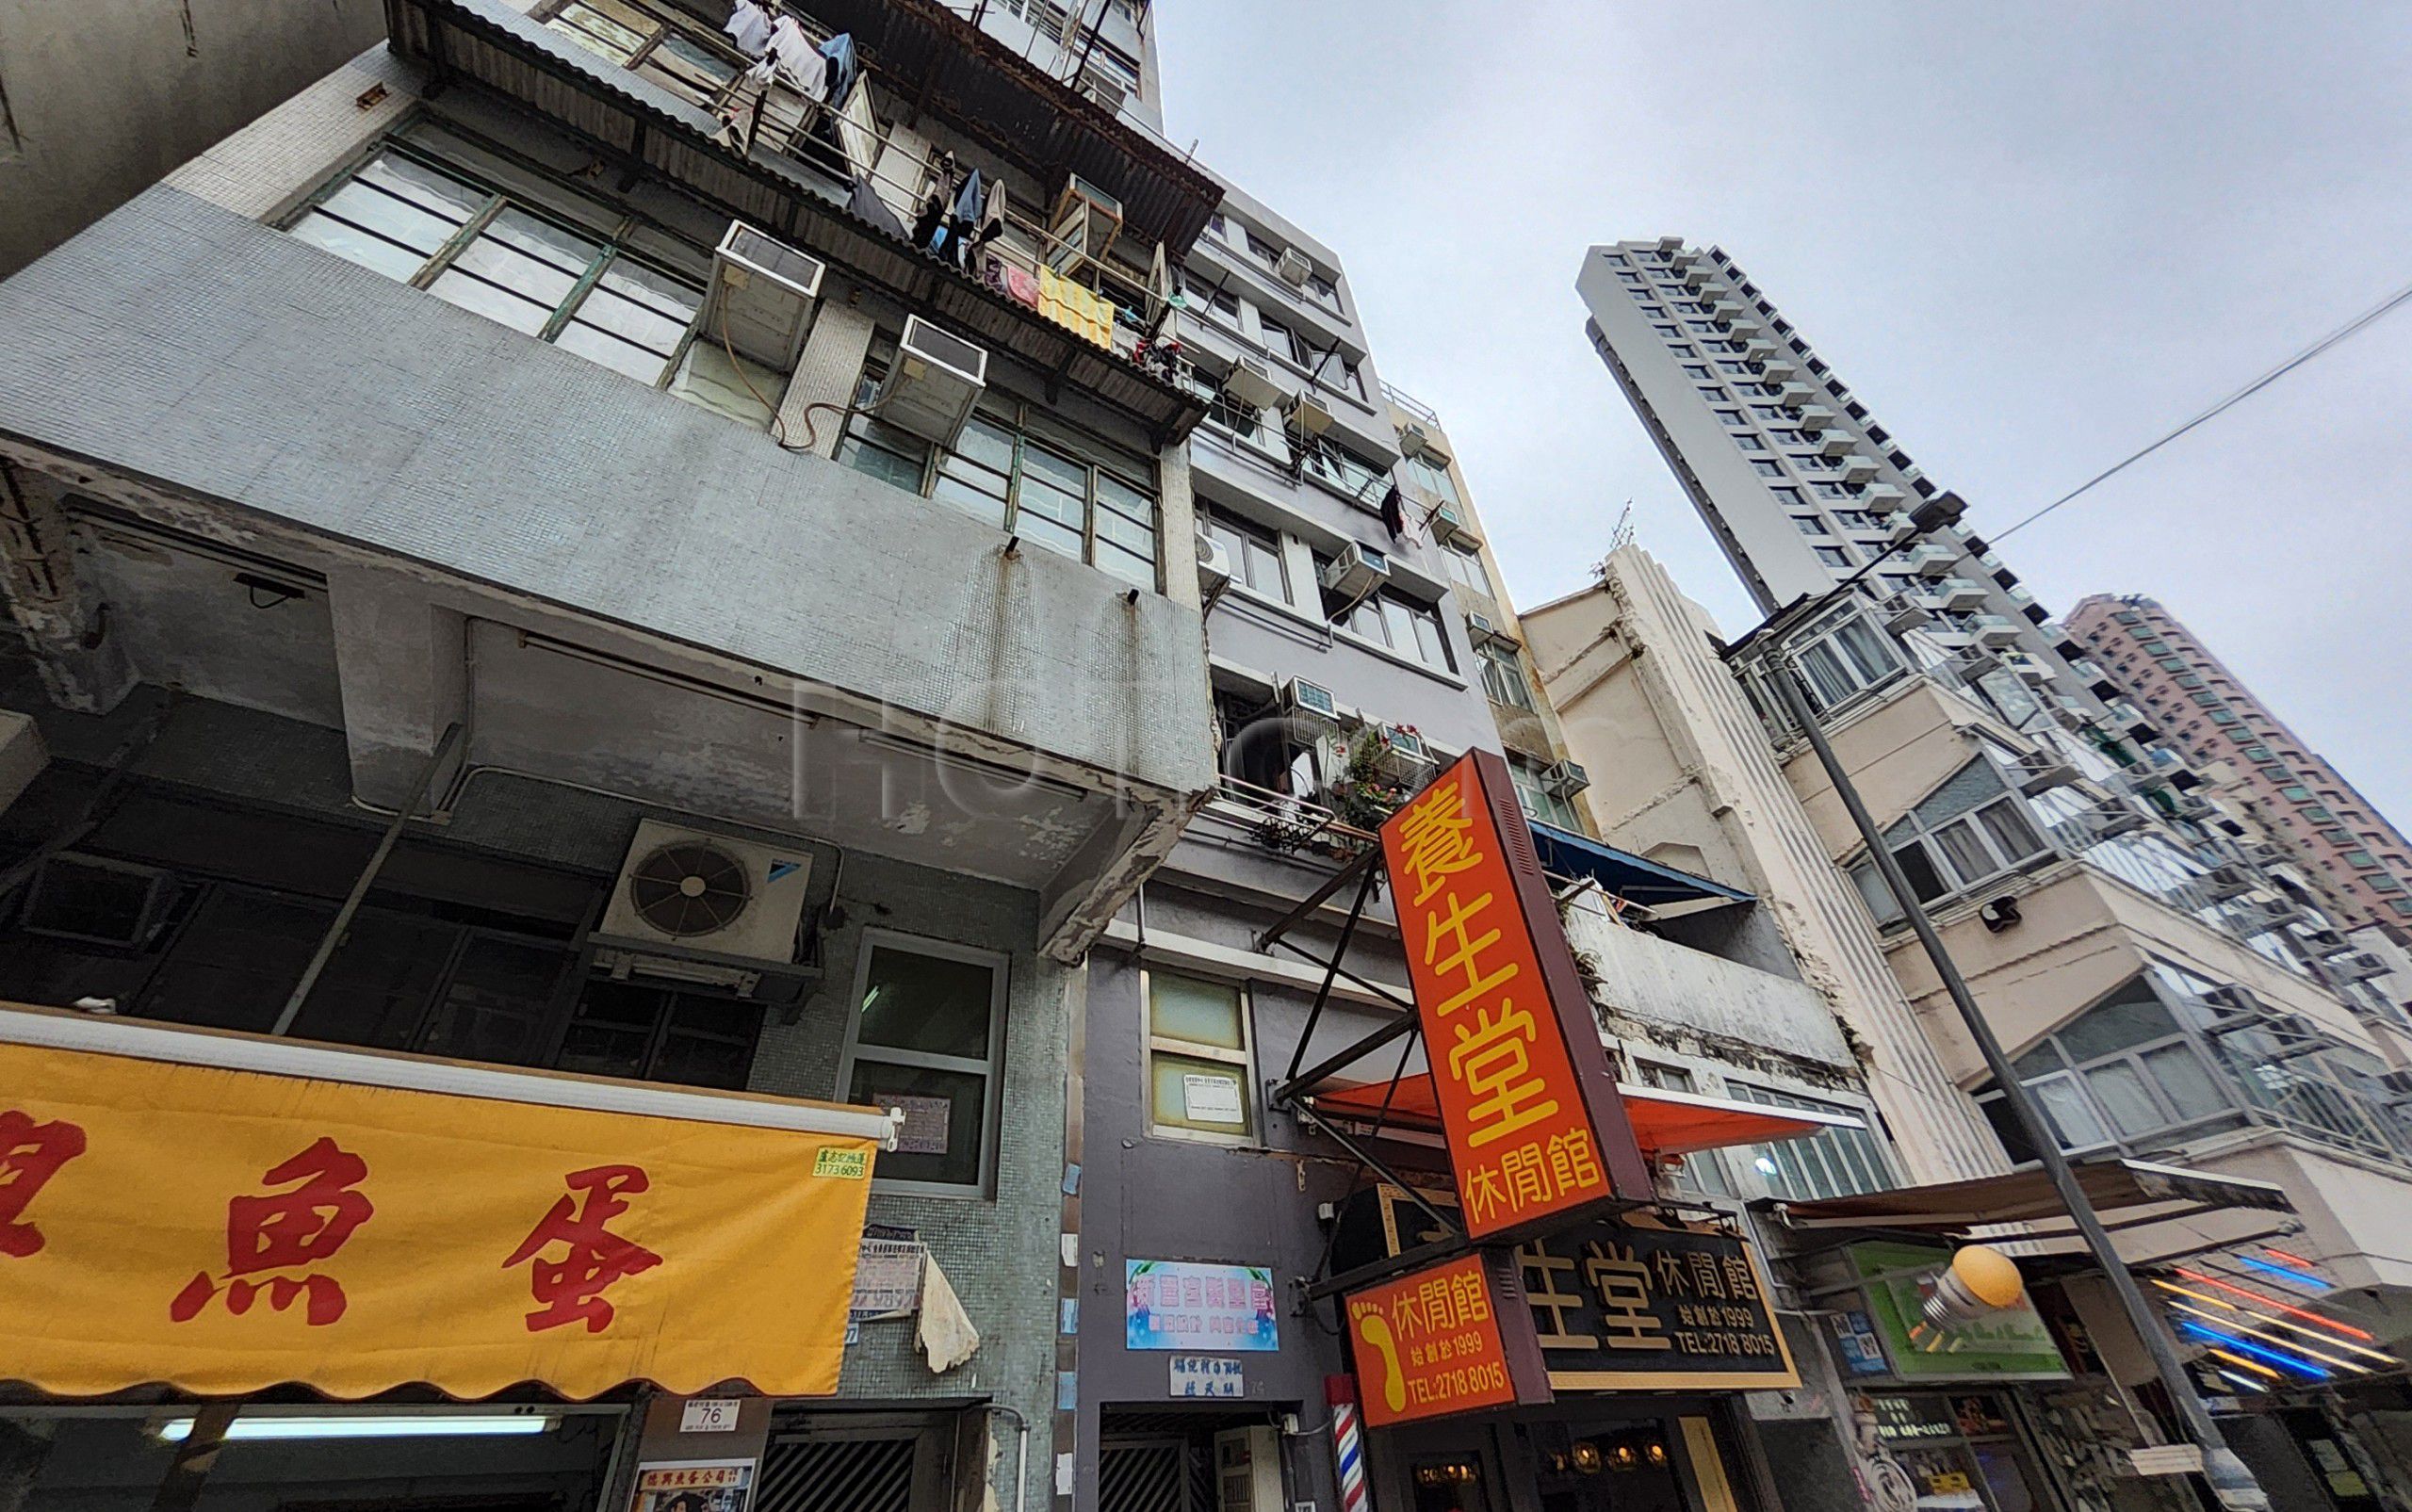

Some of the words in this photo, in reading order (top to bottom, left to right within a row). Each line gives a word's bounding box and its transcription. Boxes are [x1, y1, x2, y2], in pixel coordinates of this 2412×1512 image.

[1399, 781, 1559, 1147] 養生堂
[815, 1162, 839, 1175] 3173
[840, 1165, 864, 1177] 6093
[1465, 1128, 1600, 1224] 休閒館
[1392, 1270, 1490, 1341] 休閒館
[1513, 1235, 1672, 1350] 生堂
[701, 1407, 723, 1424] 76
